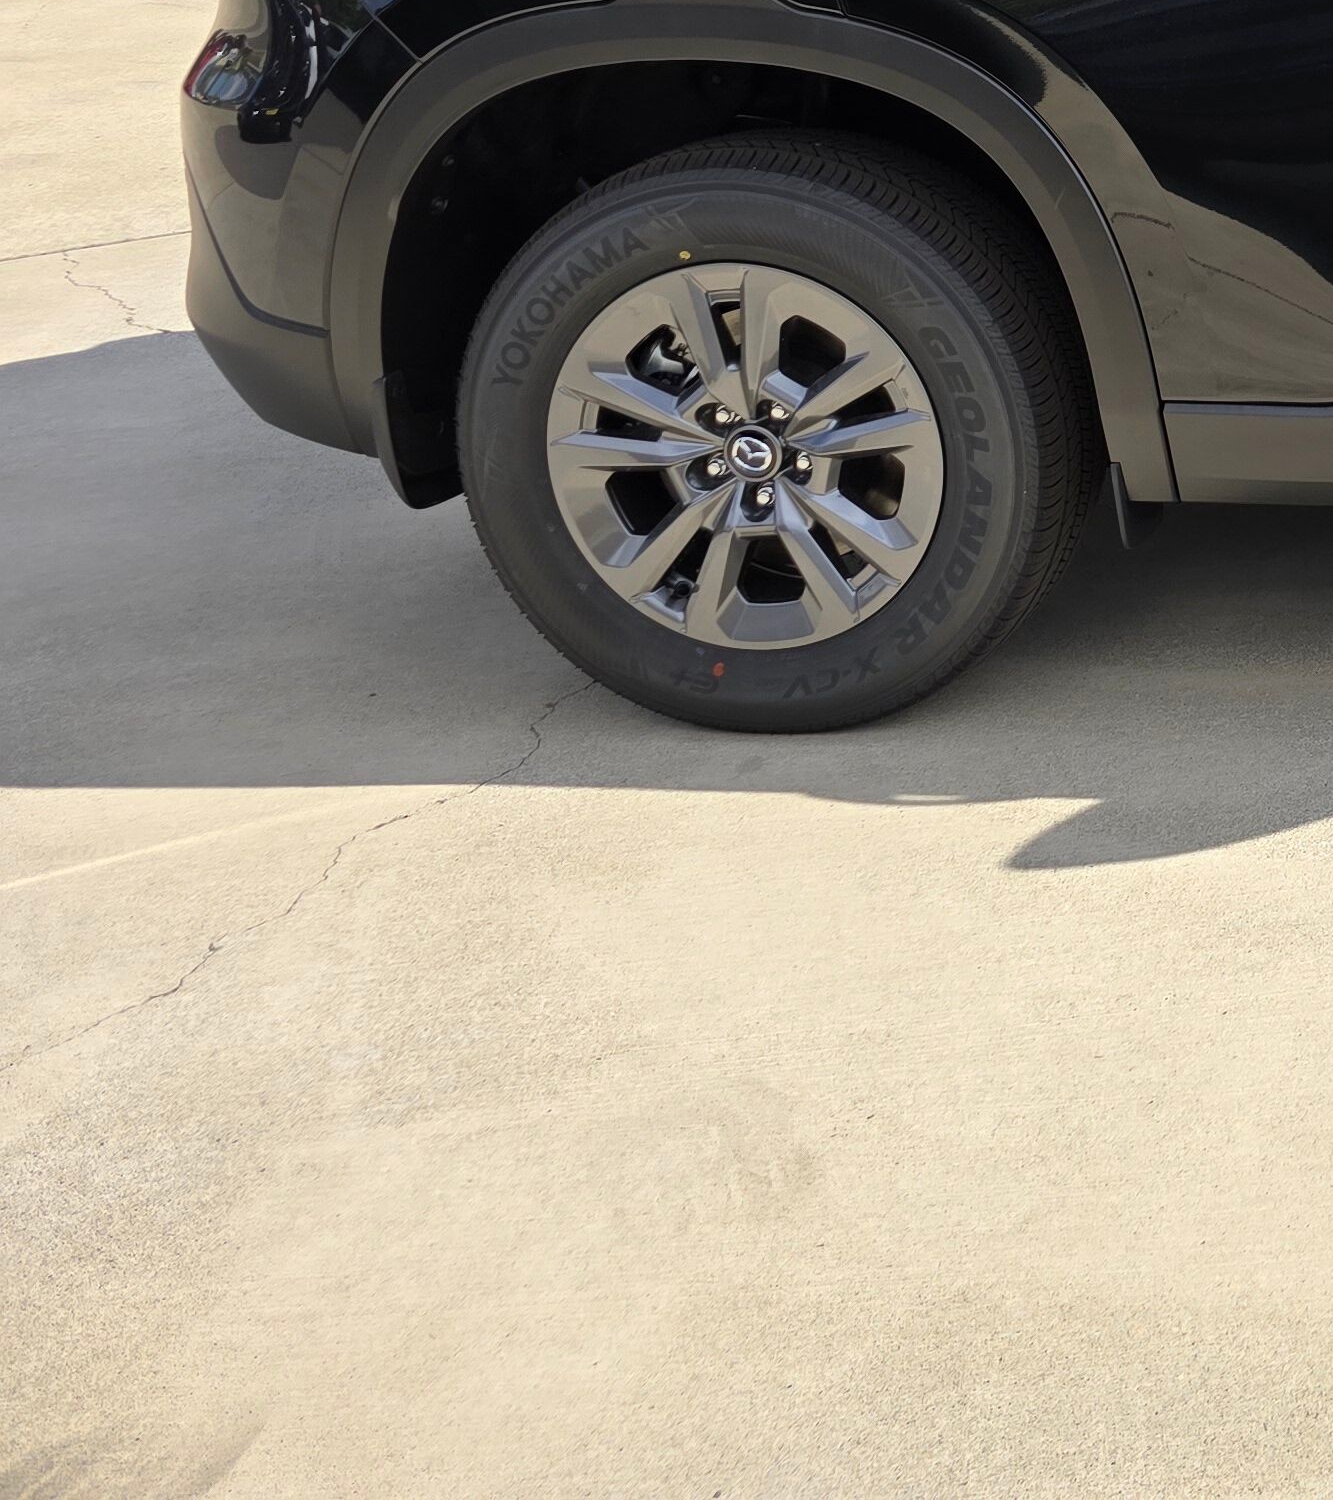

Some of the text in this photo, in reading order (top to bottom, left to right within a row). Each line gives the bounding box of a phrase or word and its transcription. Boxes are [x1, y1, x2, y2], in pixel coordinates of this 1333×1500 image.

[494, 227, 649, 390] YOKOHAMA
[782, 326, 989, 699] GEOLANDAR X-CV
